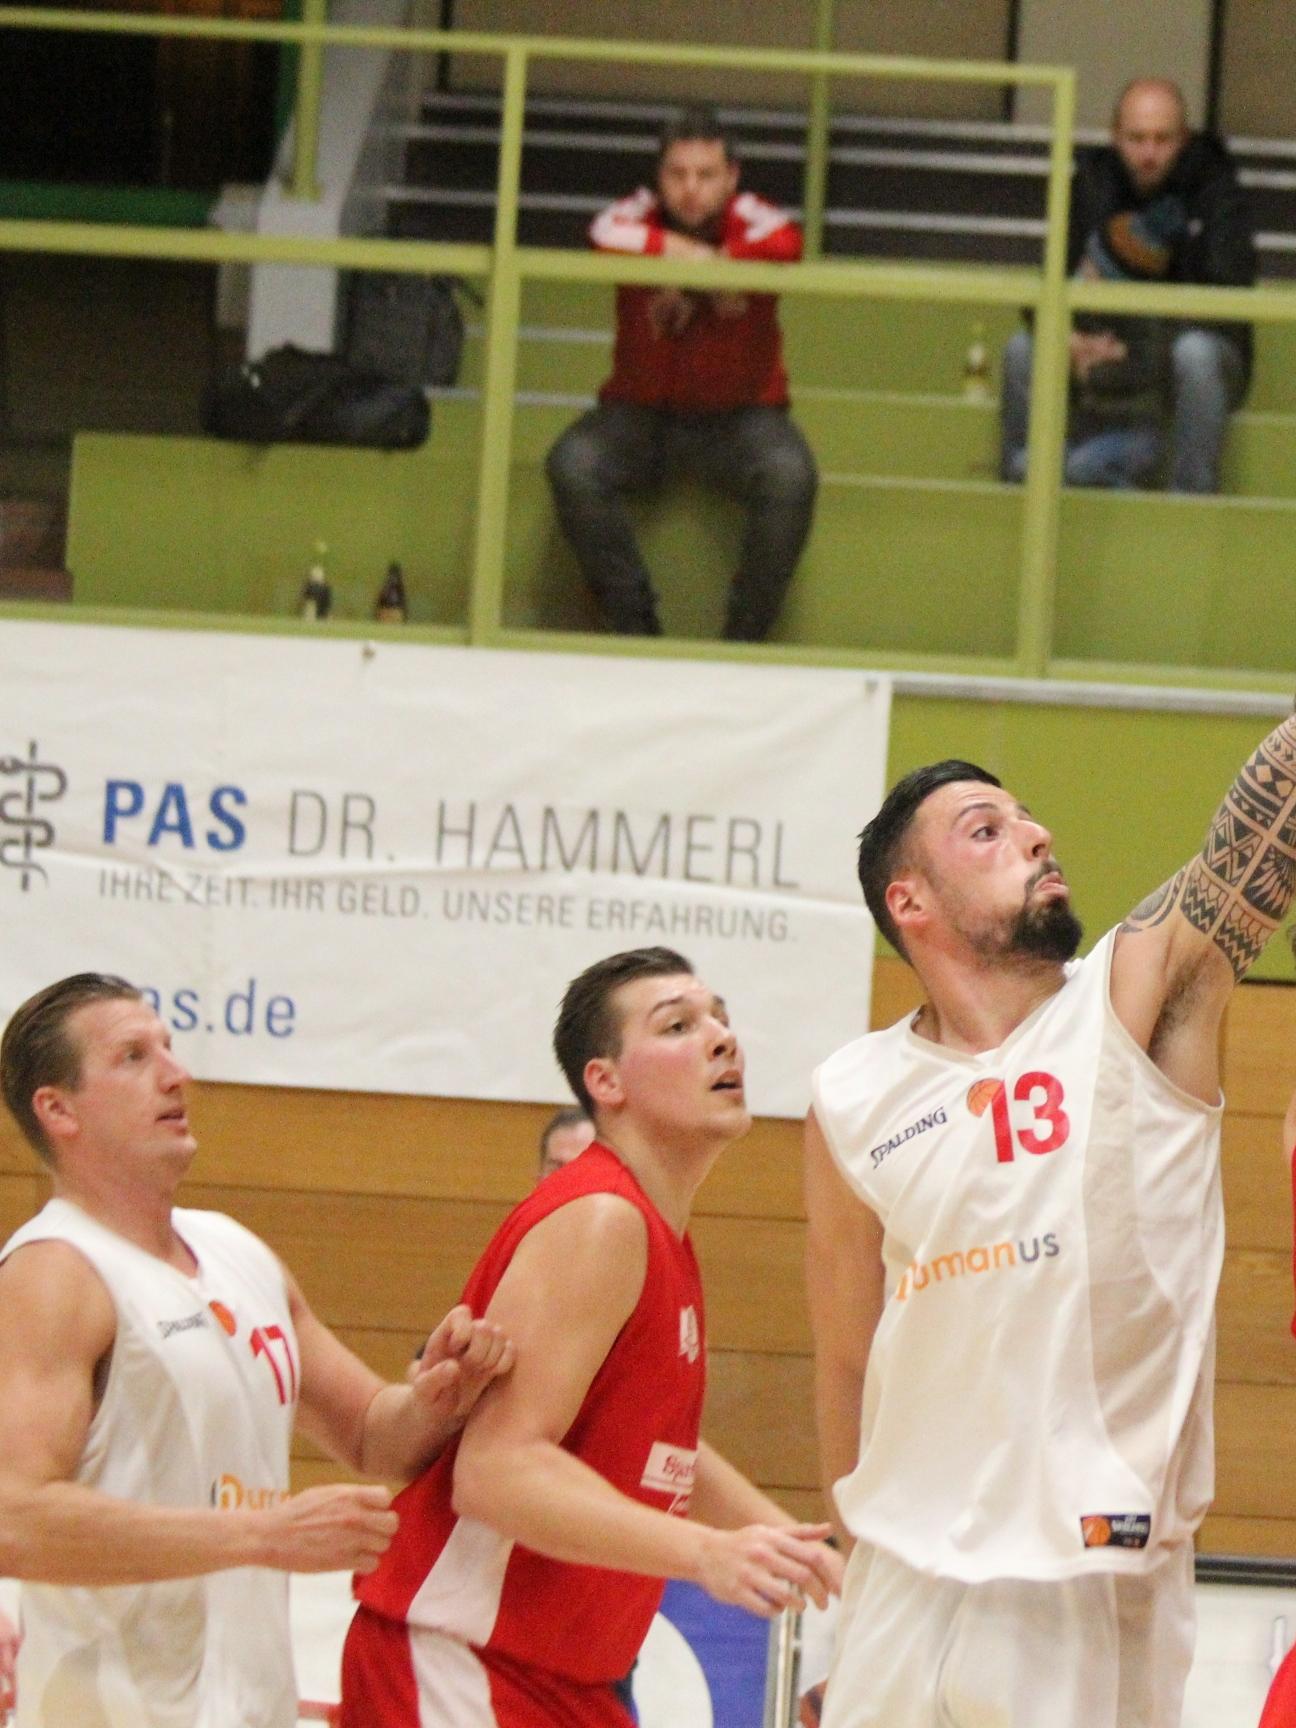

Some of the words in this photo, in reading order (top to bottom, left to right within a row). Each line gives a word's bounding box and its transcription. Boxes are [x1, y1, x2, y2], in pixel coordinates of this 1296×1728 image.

[102, 779, 249, 853] PAS
[287, 789, 397, 863] DR.
[435, 799, 800, 890] HAMMERL
[99, 867, 174, 903] IHRE
[183, 872, 259, 908] ZEIT.
[270, 879, 326, 913] IHR
[336, 882, 430, 919] GELD.
[442, 888, 577, 931] UNSERE
[586, 897, 800, 944] ERFAHRUNG.
[870, 1106, 948, 1170] SPALDING
[967, 1071, 1071, 1164] 13
